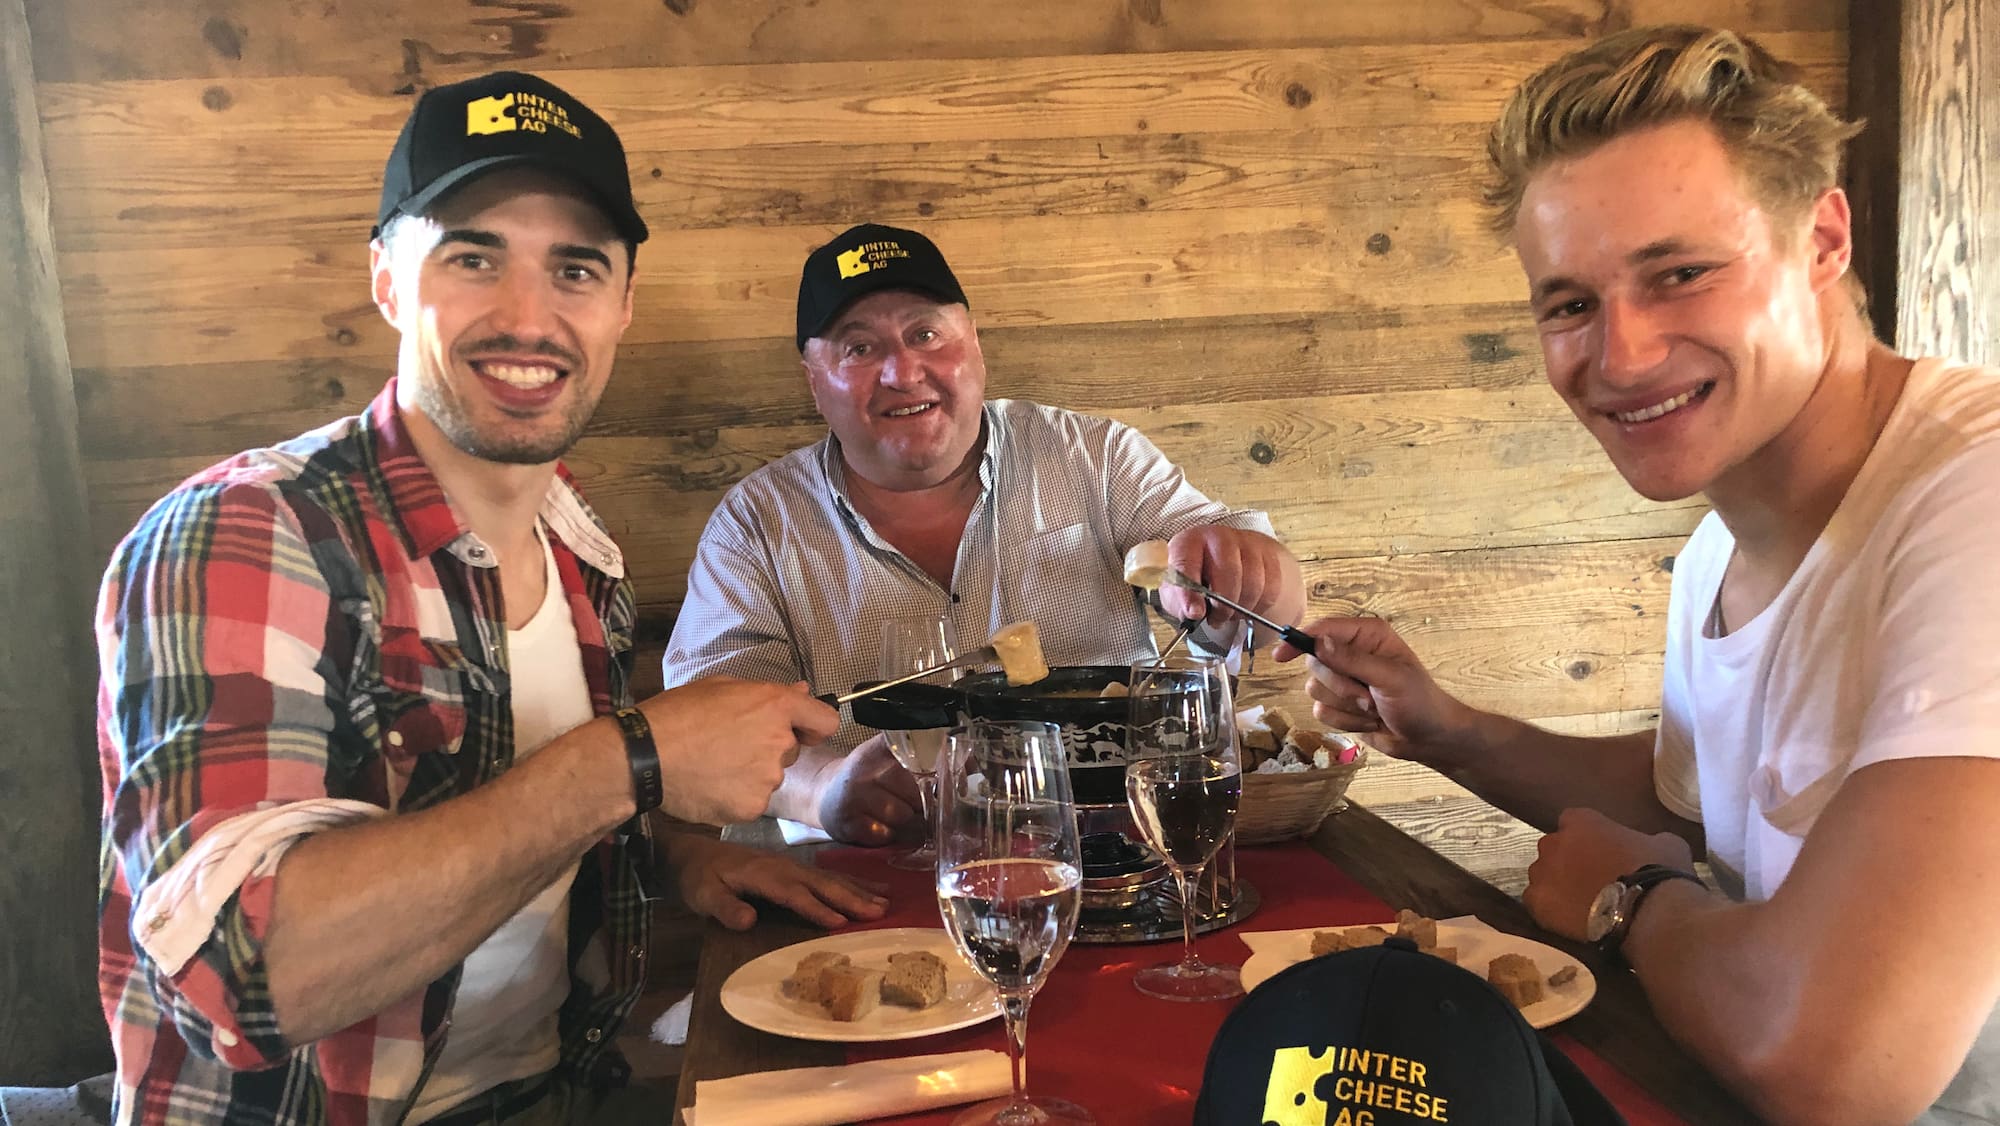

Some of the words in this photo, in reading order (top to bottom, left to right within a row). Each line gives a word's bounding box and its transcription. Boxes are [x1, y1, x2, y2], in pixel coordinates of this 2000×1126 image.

[516, 92, 569, 121] INTER
[517, 106, 582, 138] CHEESE
[521, 118, 547, 133] AG
[864, 241, 899, 252] INTER
[872, 260, 888, 270] AG
[1338, 1047, 1427, 1087] INTER
[1334, 1077, 1449, 1122] CHEESE
[1333, 1106, 1375, 1126] AG
